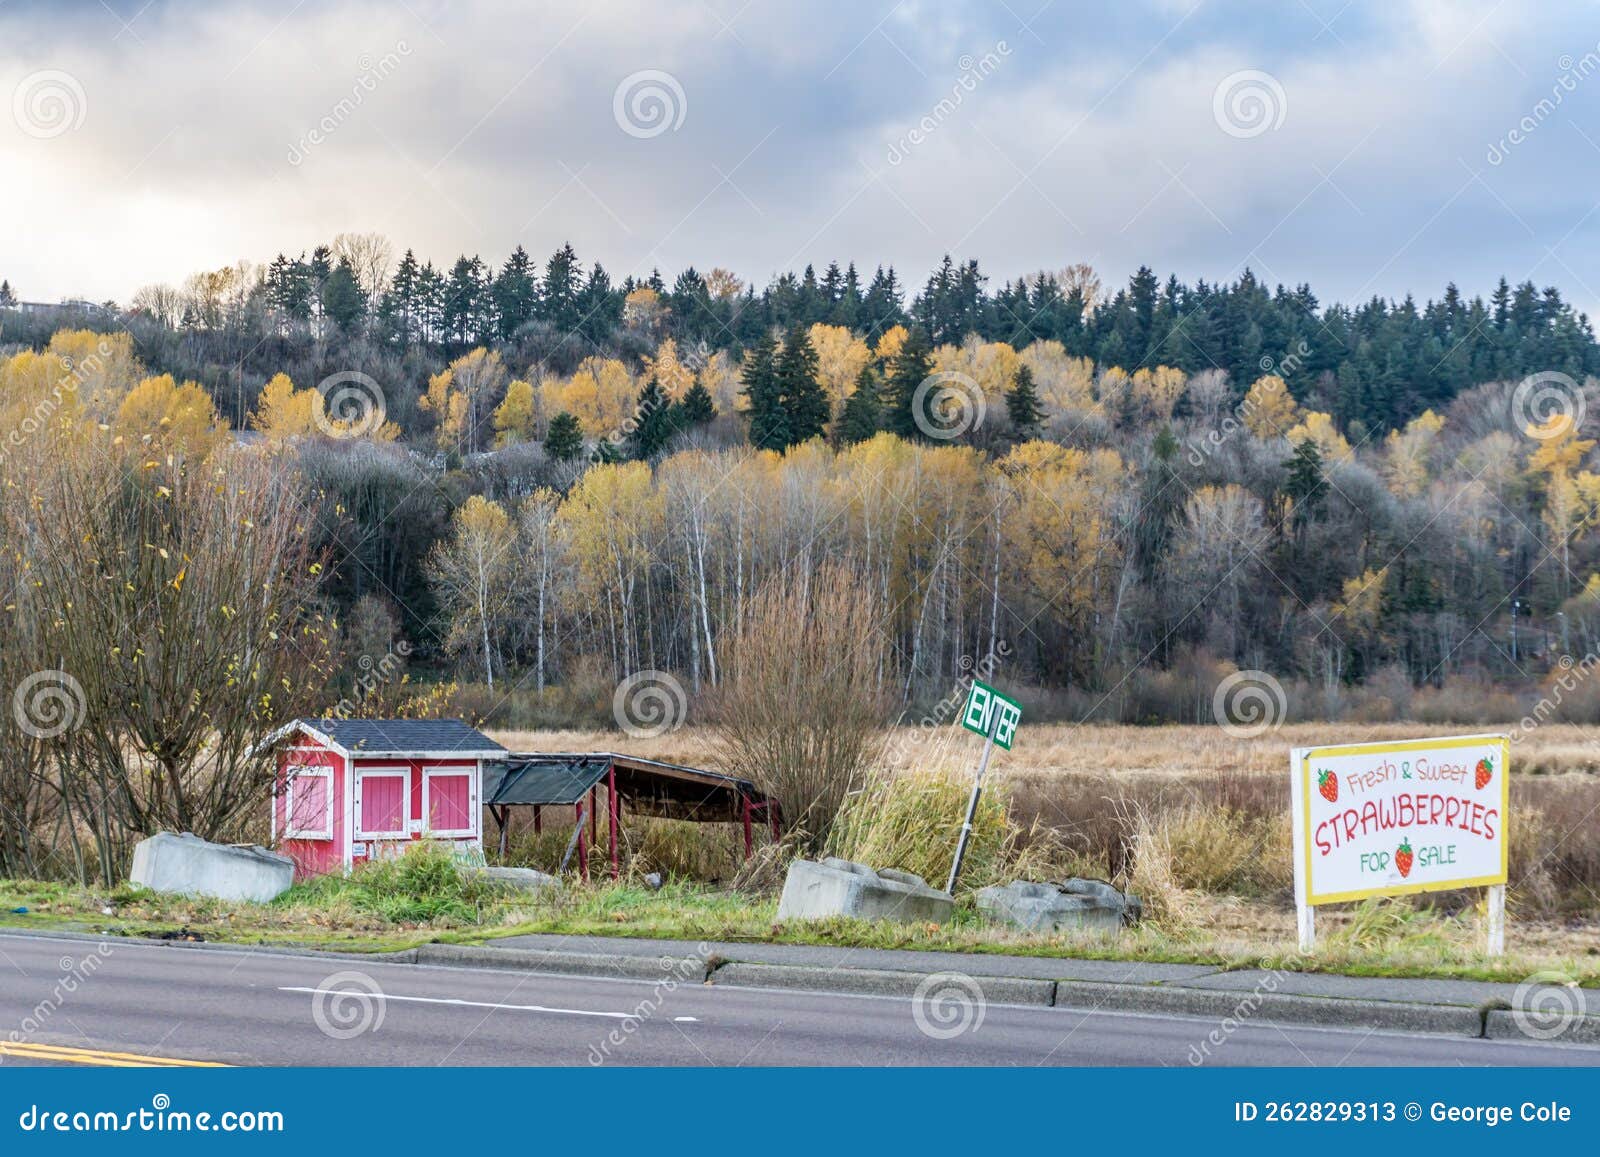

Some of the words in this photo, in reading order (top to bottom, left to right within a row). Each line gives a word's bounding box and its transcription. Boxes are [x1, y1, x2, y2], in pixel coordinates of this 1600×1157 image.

[1347, 760, 1397, 795] Fresh
[1401, 761, 1412, 779] &
[1415, 758, 1468, 785] Sweet
[1315, 793, 1498, 856] STRAWBERRIES
[1360, 852, 1390, 873] FOR
[1418, 845, 1457, 866] SALE
